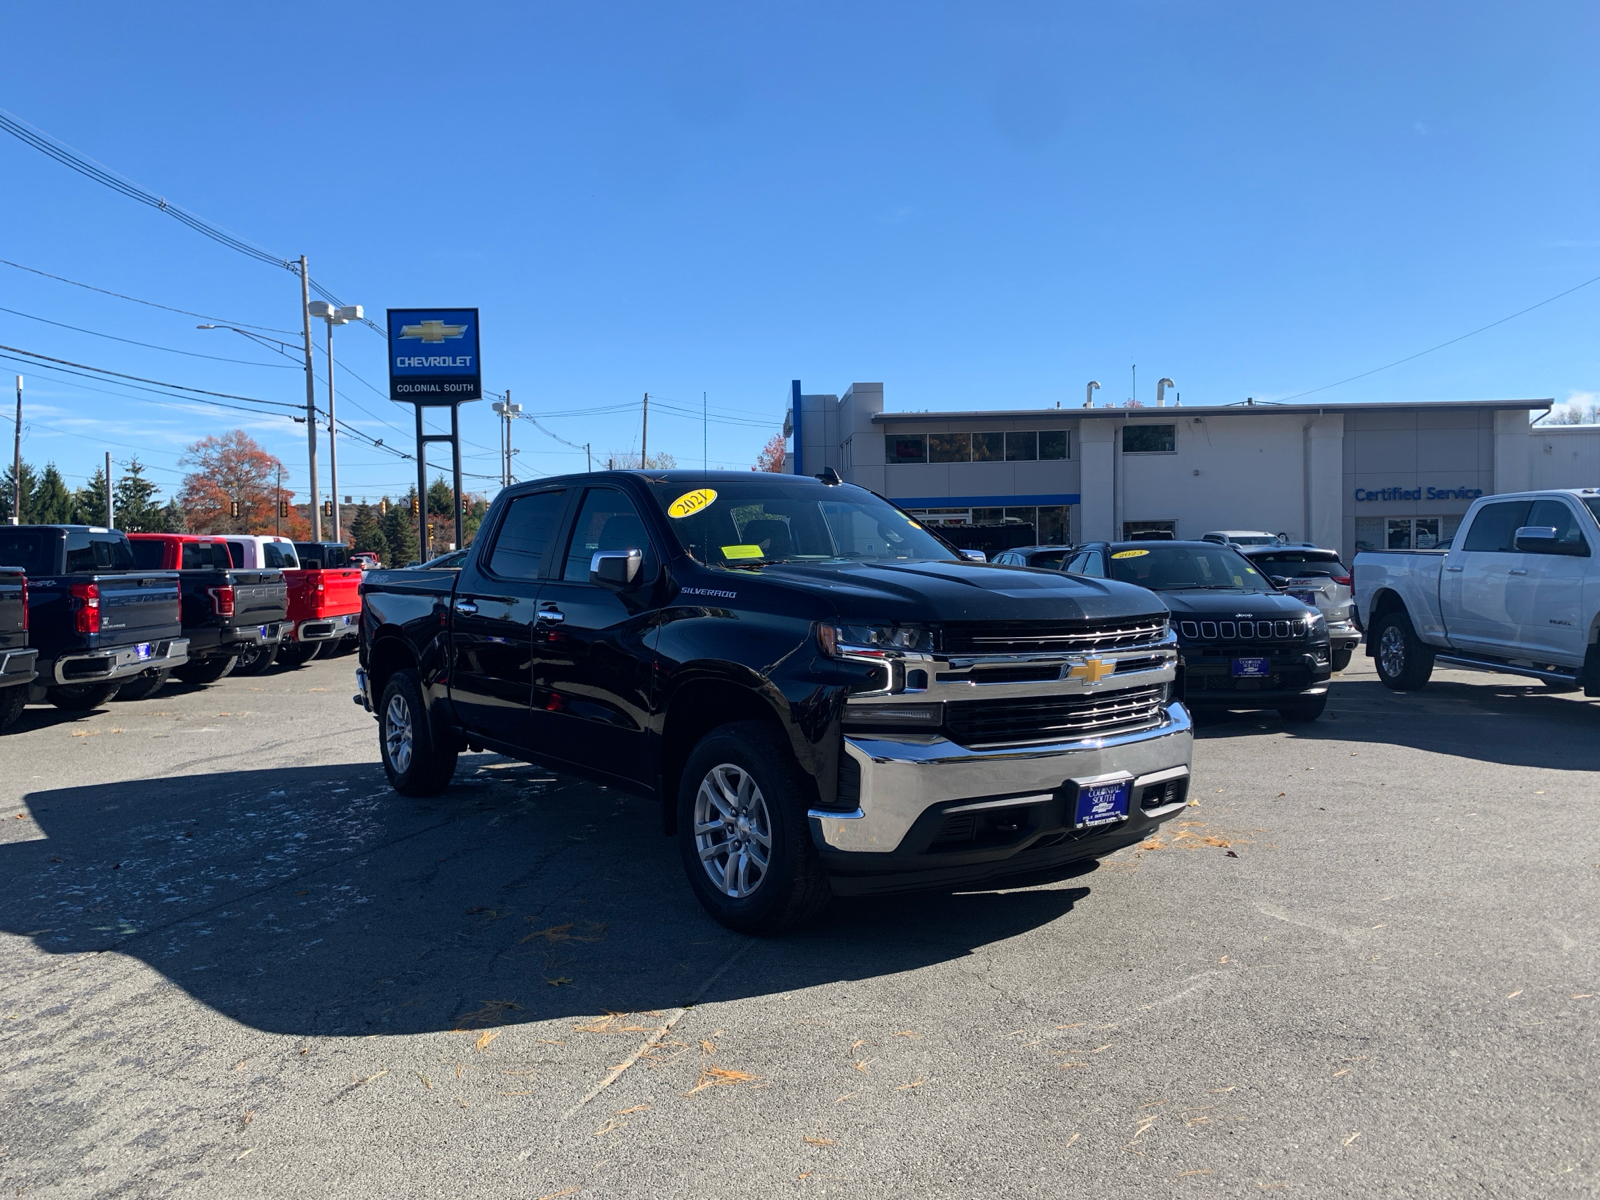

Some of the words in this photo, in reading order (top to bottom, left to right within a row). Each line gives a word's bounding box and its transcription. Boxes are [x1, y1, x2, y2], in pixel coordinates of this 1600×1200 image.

[396, 356, 472, 367] CHEVROLET
[396, 384, 441, 393] COLONIAL
[443, 383, 474, 392] SOUTH
[1355, 487, 1421, 501] Certified
[1426, 486, 1483, 500] Service
[676, 491, 708, 514] 2021
[237, 587, 287, 600] FORD
[680, 586, 737, 598] SILVERADO
[1088, 786, 1121, 797] COLONIAL
[1092, 793, 1115, 804] SOUTH
